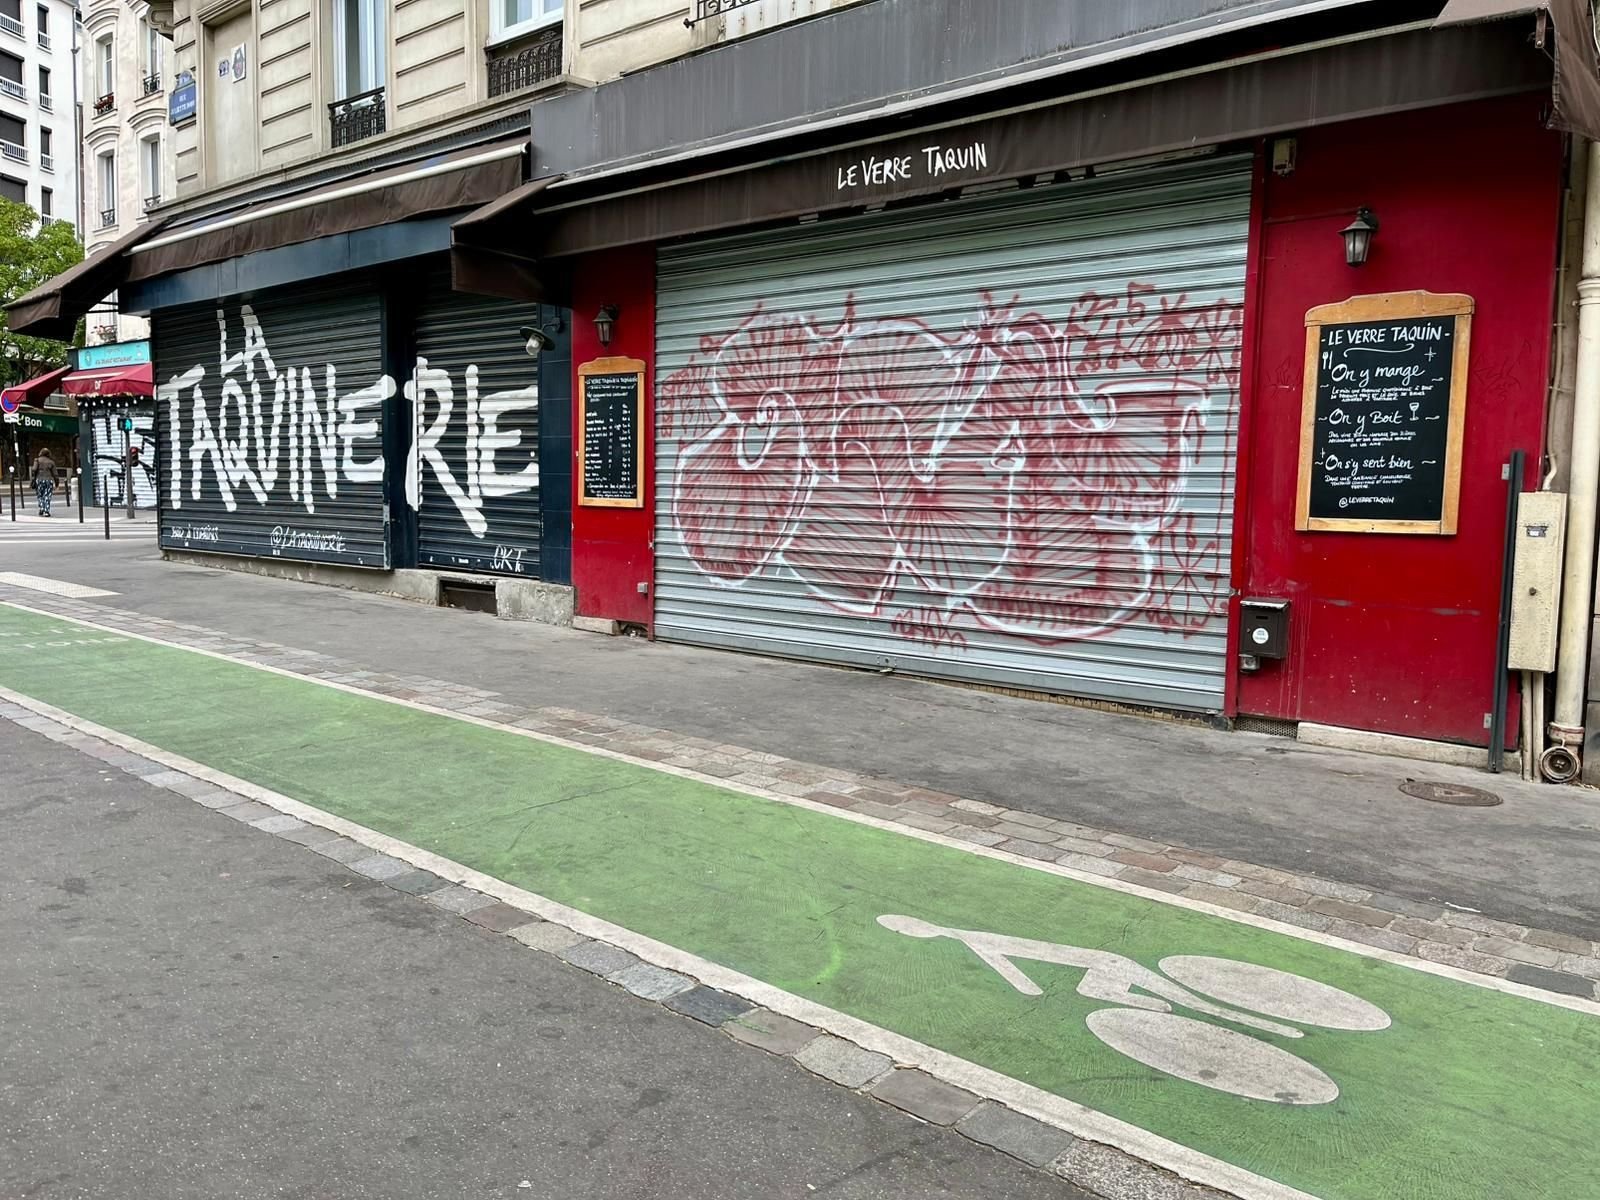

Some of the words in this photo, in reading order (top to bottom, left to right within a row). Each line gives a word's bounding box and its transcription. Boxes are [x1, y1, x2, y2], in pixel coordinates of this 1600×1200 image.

[837, 165, 858, 190] LE
[861, 156, 912, 186] VERRE
[921, 142, 987, 177] TAQUIN
[216, 303, 277, 381] LA
[1328, 329, 1344, 346] LE
[1347, 328, 1387, 344] VERRE
[1331, 363, 1357, 382] On
[1358, 369, 1370, 388] y
[1375, 365, 1426, 387] mange
[1329, 408, 1352, 425] On
[1355, 415, 1366, 434] y
[1369, 410, 1403, 424] Boit
[1325, 454, 1343, 471] On
[1344, 458, 1359, 476] s'y
[1362, 455, 1386, 468] sent
[1388, 454, 1415, 469] bien
